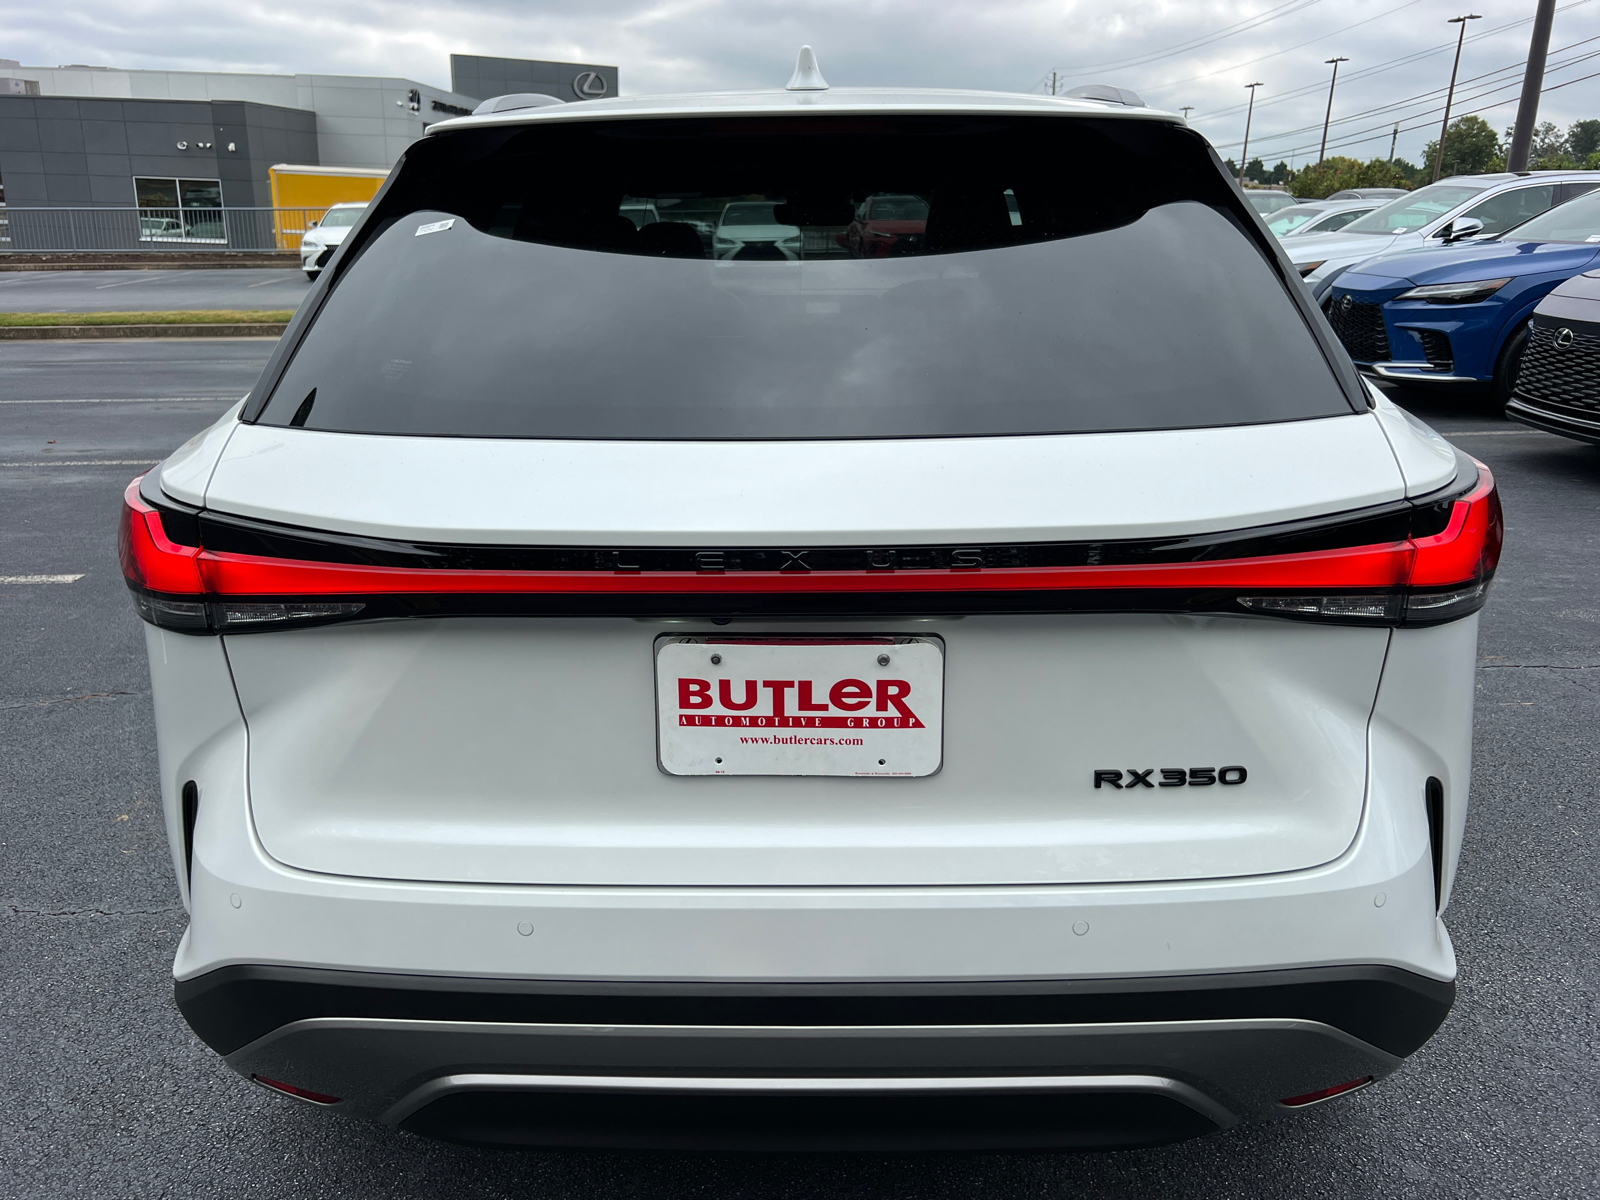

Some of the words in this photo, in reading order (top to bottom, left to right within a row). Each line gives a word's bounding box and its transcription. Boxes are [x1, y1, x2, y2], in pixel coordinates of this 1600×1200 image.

[612, 549, 983, 576] LEXUS
[679, 716, 823, 728] AUTOMOTIVE
[847, 717, 916, 728] GROUP
[739, 734, 864, 746] www.butlercars.com
